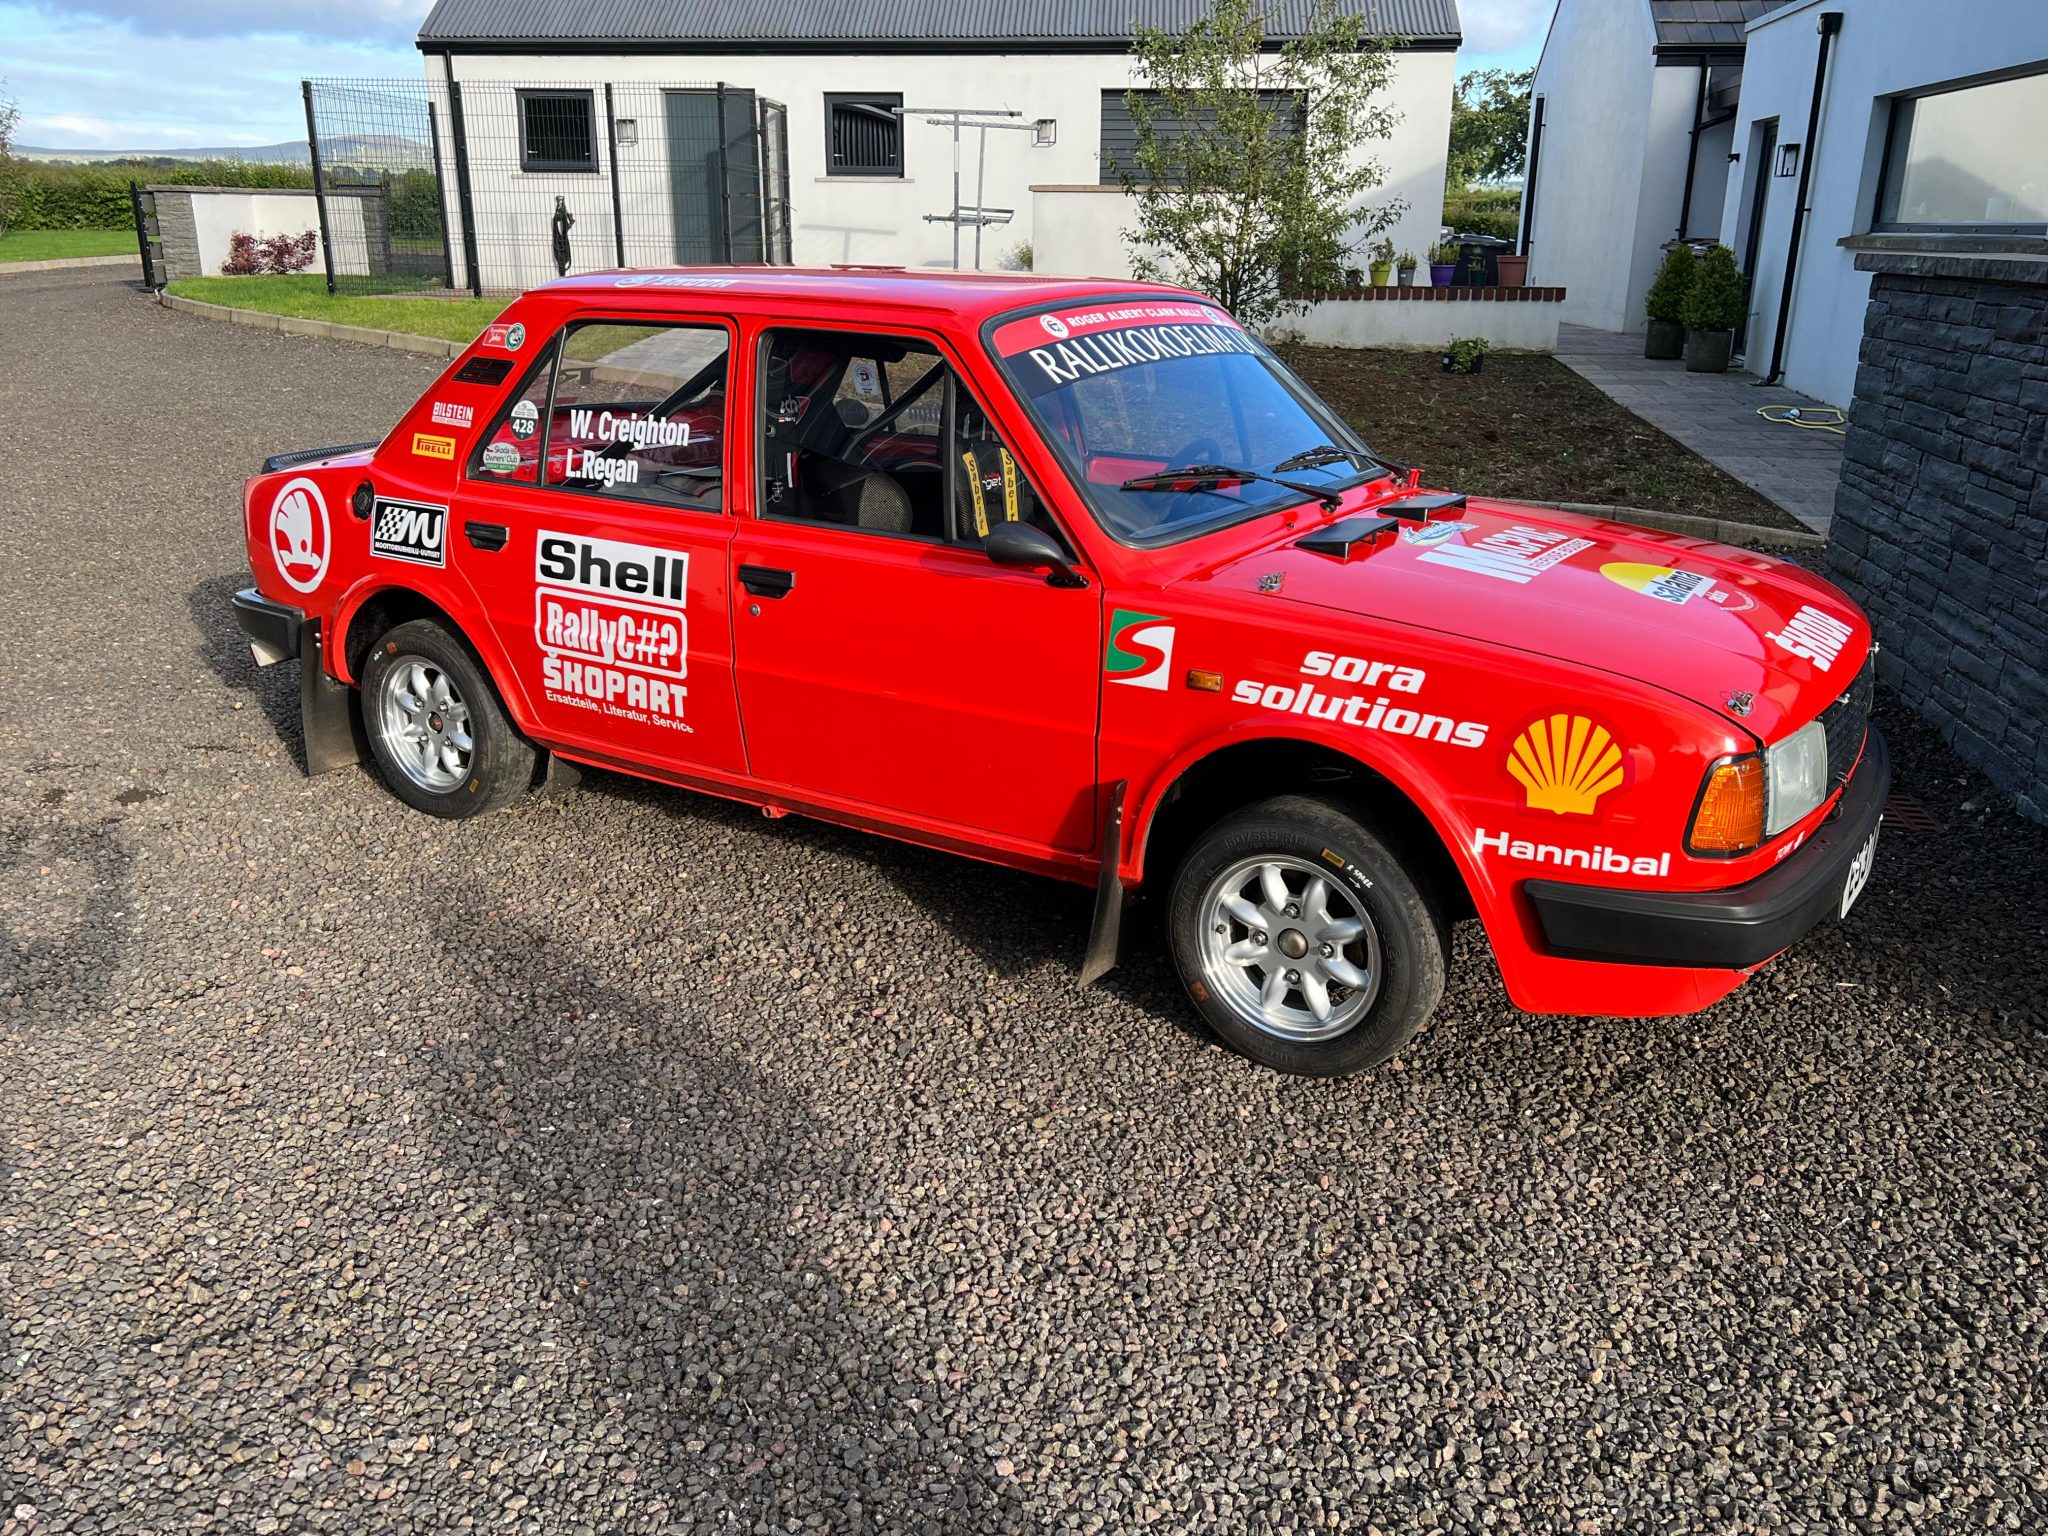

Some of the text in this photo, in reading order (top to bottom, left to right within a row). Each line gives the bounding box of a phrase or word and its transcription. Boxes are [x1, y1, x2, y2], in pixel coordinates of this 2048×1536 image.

[1067, 314, 1105, 328] ROGER
[1107, 308, 1147, 321] ALBERT
[1148, 307, 1177, 318] CLARK
[433, 401, 474, 421] BILSTEIN
[512, 418, 535, 434] 428
[570, 409, 594, 439] W.
[598, 411, 690, 450] Creighton
[416, 438, 452, 455] PIRELLI
[540, 537, 684, 601] Shell
[1416, 525, 1569, 584] MACPAC
[1651, 570, 1704, 604] salama
[1765, 605, 1853, 672] ŠKODA
[543, 651, 688, 718] ŠKOPART
[1300, 650, 1426, 694] sora
[545, 689, 694, 734] Ersatzteile, Literatur, Service
[1231, 680, 1489, 748] solutions
[1473, 827, 1671, 877] Hannibal
